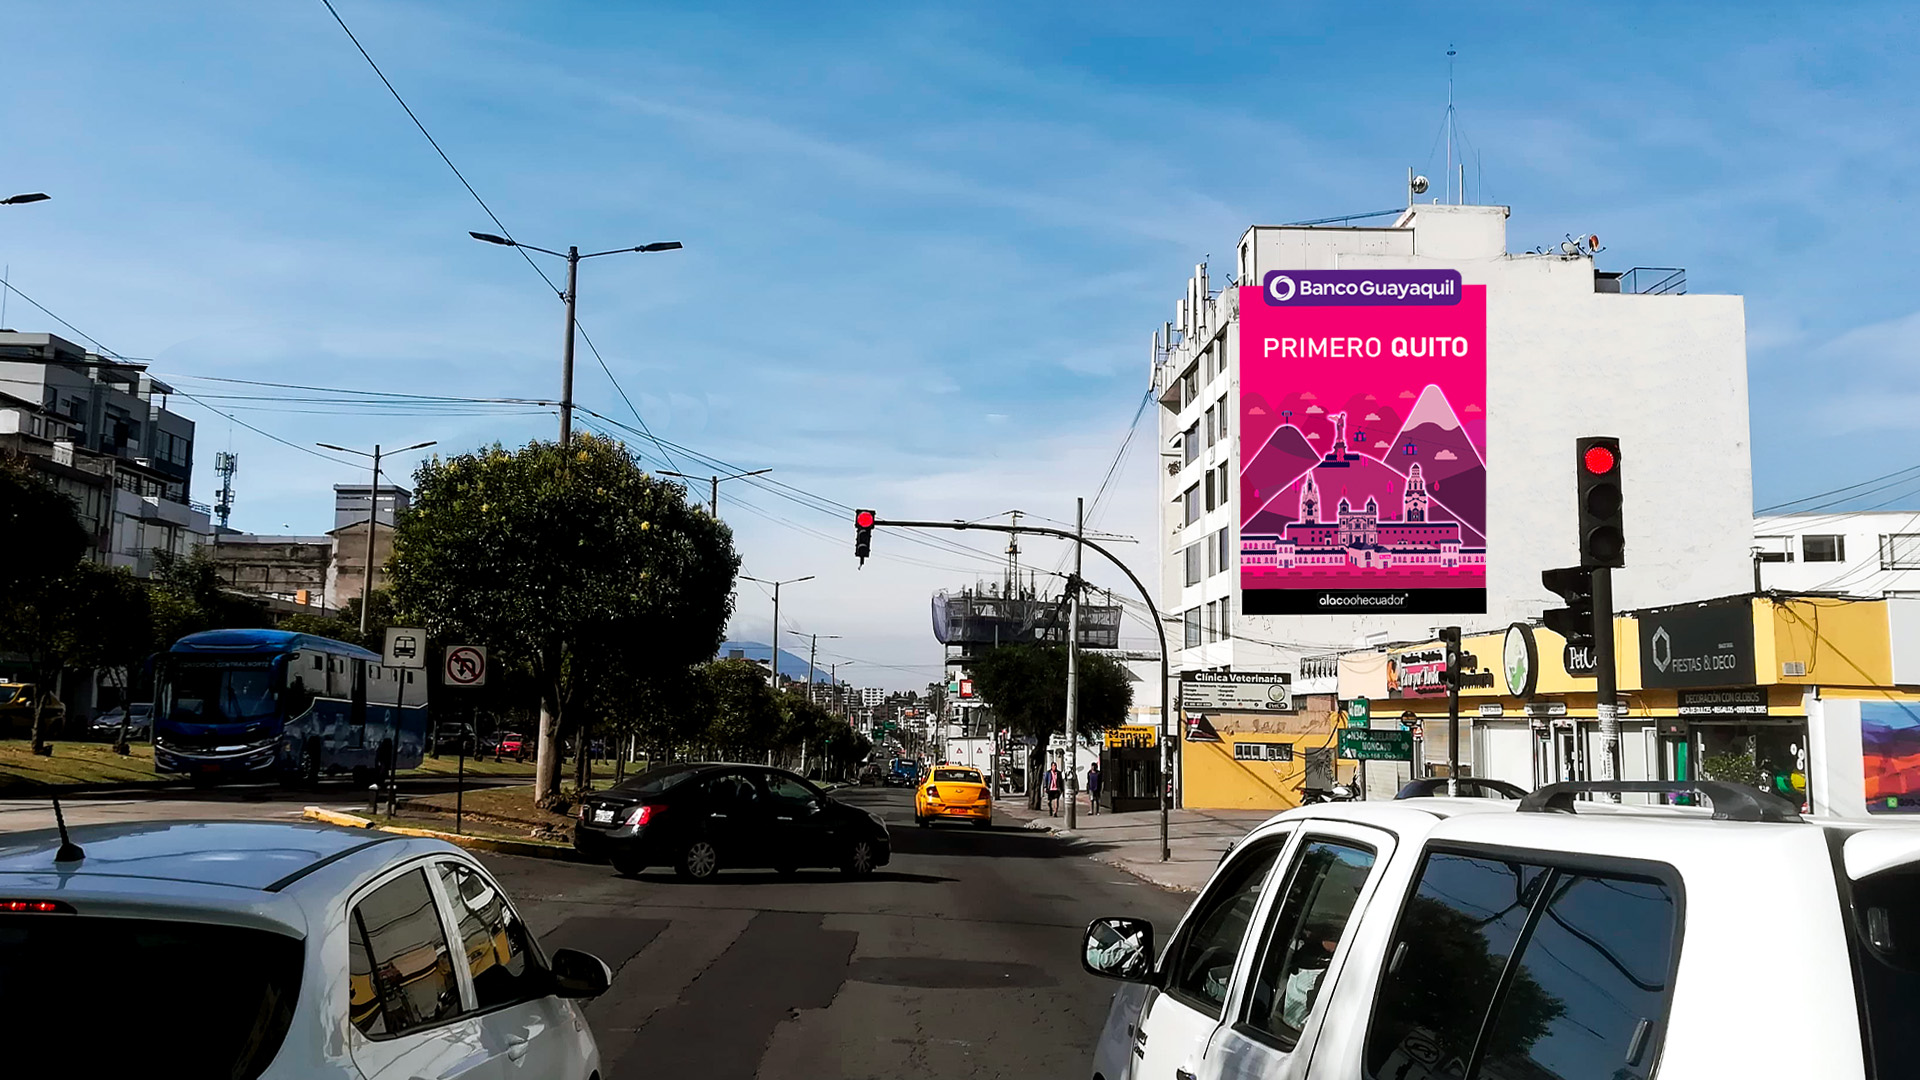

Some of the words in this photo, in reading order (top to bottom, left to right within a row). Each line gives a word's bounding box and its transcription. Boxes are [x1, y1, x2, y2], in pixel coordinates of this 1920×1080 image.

[1264, 337, 1382, 358] PRIMERO
[1391, 336, 1468, 358] QUITO
[1672, 657, 1702, 673] FIESTAS
[1703, 654, 1712, 671] &
[1713, 654, 1736, 670] DECO
[1195, 673, 1228, 682] Clínica
[1229, 673, 1283, 683] Veterinaria
